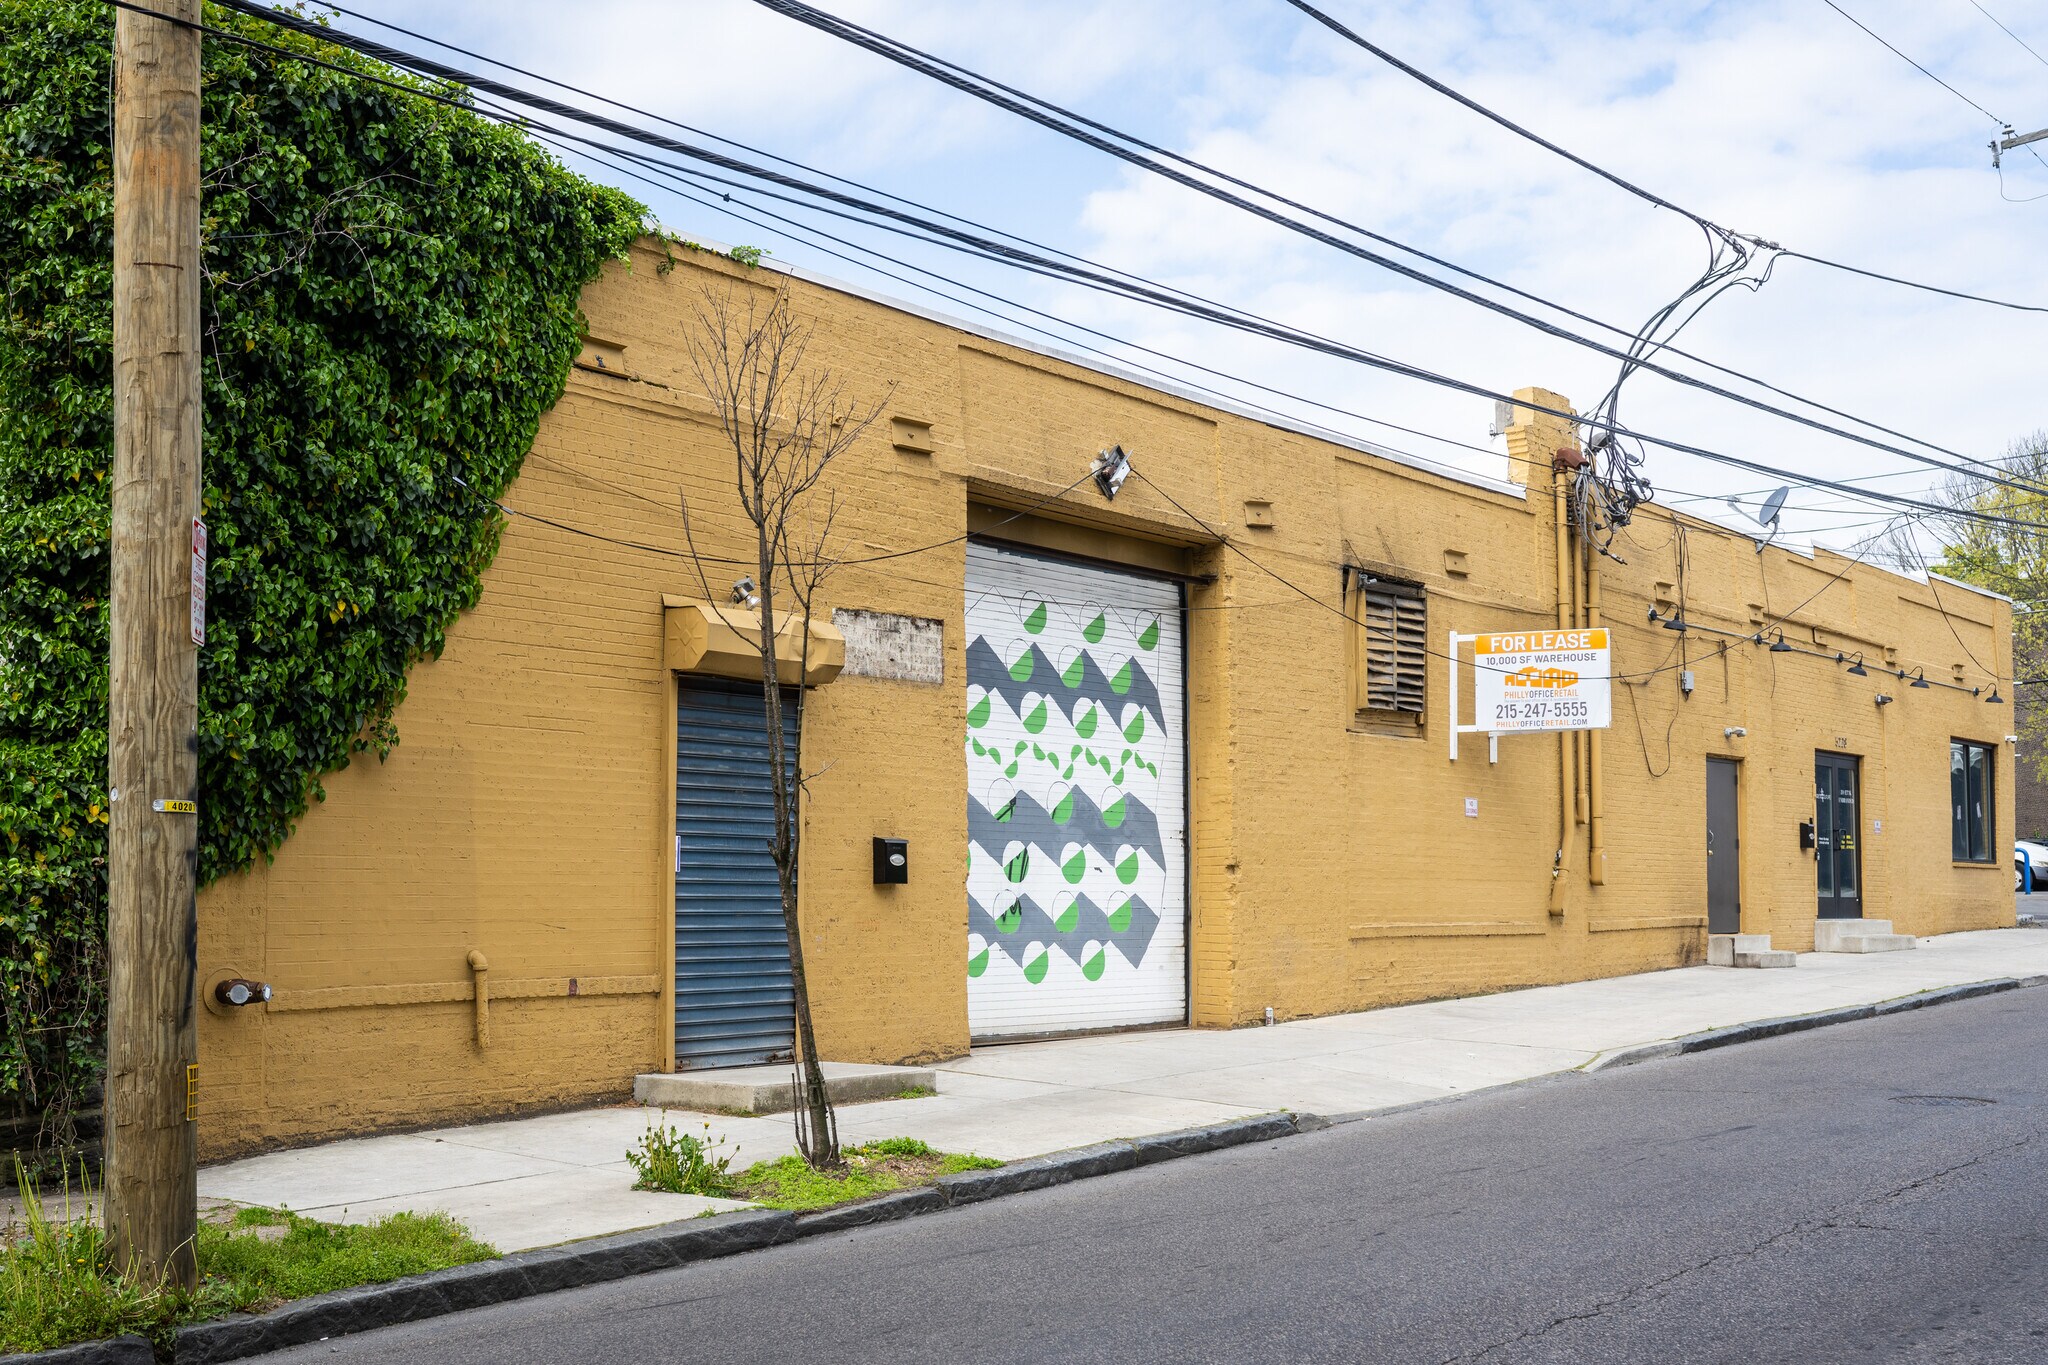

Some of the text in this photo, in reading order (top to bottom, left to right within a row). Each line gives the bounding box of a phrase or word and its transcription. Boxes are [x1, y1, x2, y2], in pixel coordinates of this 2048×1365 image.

[1490, 633, 1592, 652] FOR LEASE
[1486, 652, 1597, 666] 10,000 SF WAREHOUSE
[1504, 689, 1579, 699] PHILLYOFFICERETAIL
[1496, 701, 1588, 719] 215-247-5555
[1496, 719, 1588, 728] PHILLYOFFICERETAIL.COM
